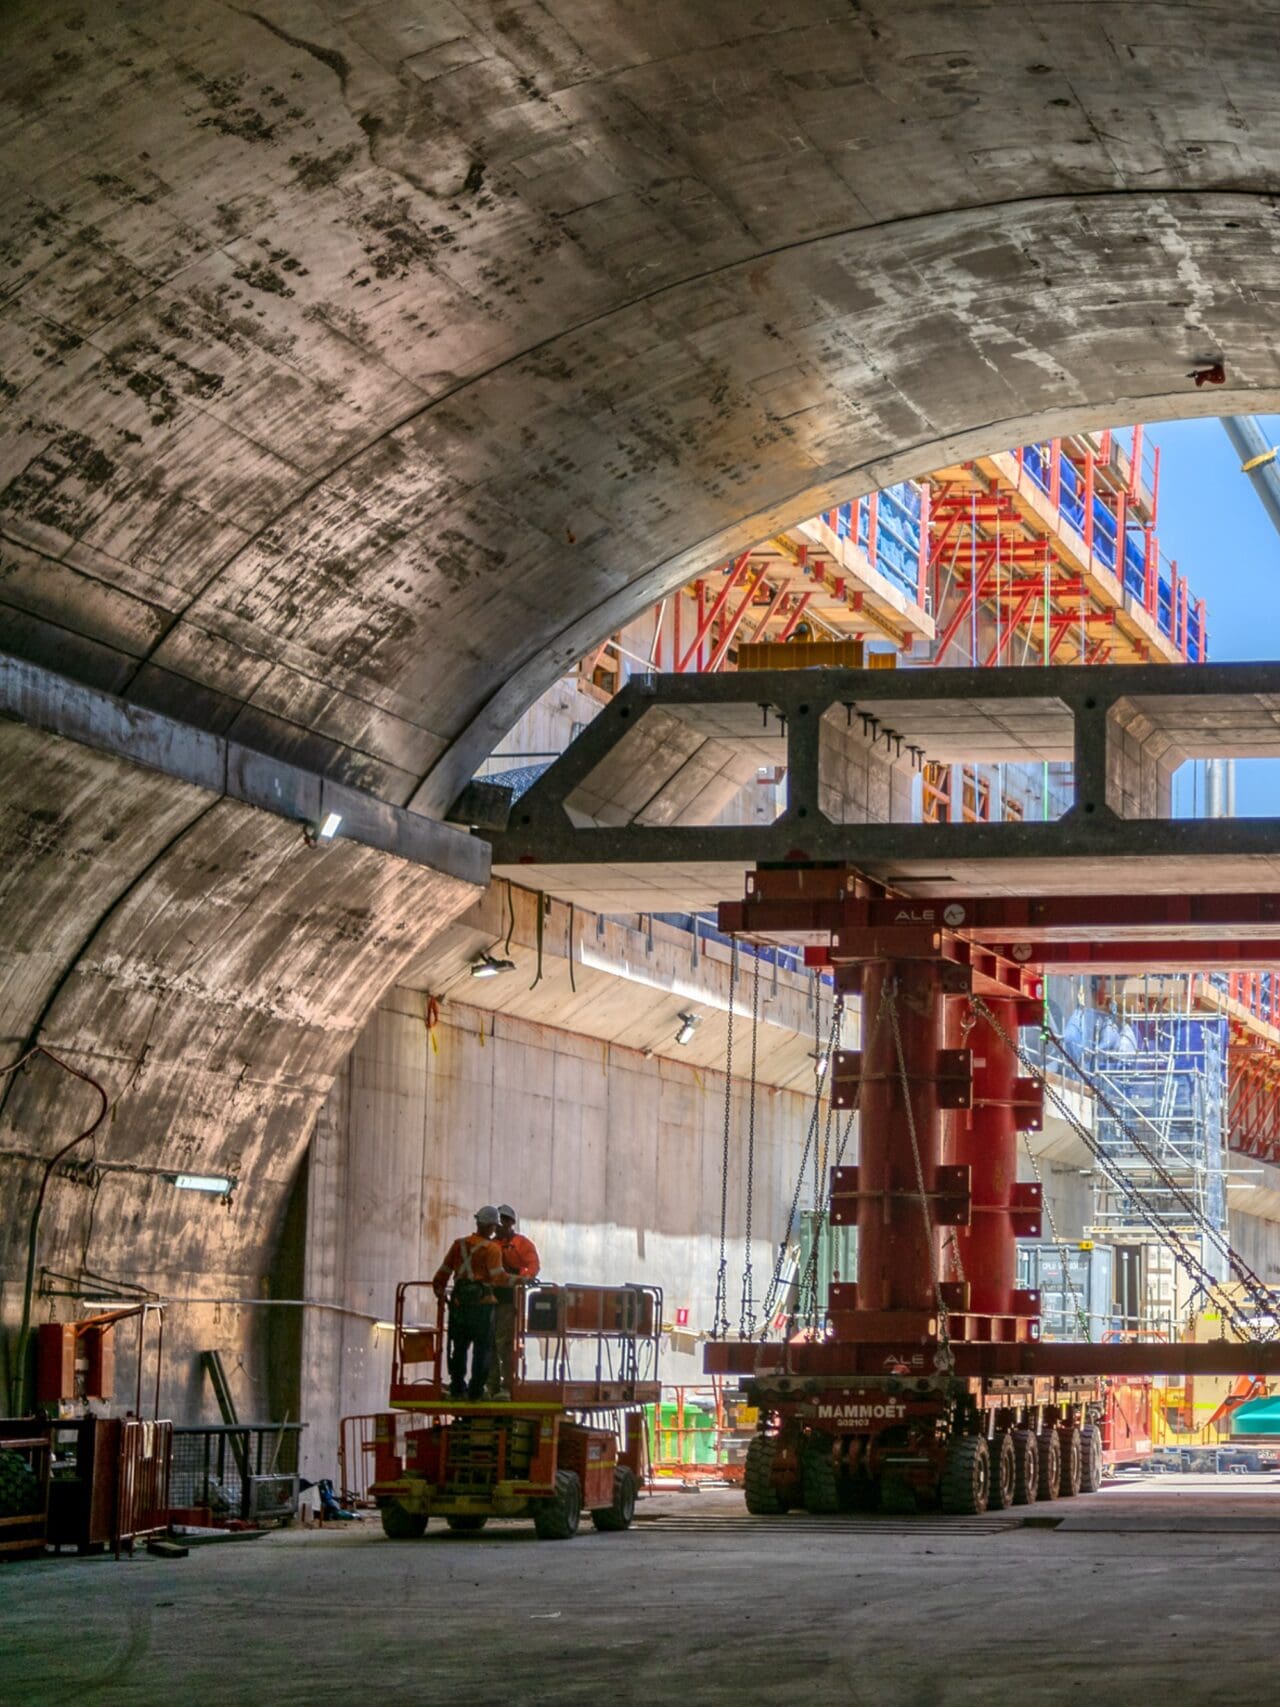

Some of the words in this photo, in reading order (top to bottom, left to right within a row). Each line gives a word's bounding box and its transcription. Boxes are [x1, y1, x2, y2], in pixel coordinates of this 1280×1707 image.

[894, 910, 935, 921] ALE
[883, 1354, 925, 1366] ALE
[818, 1405, 907, 1418] MAMMOET
